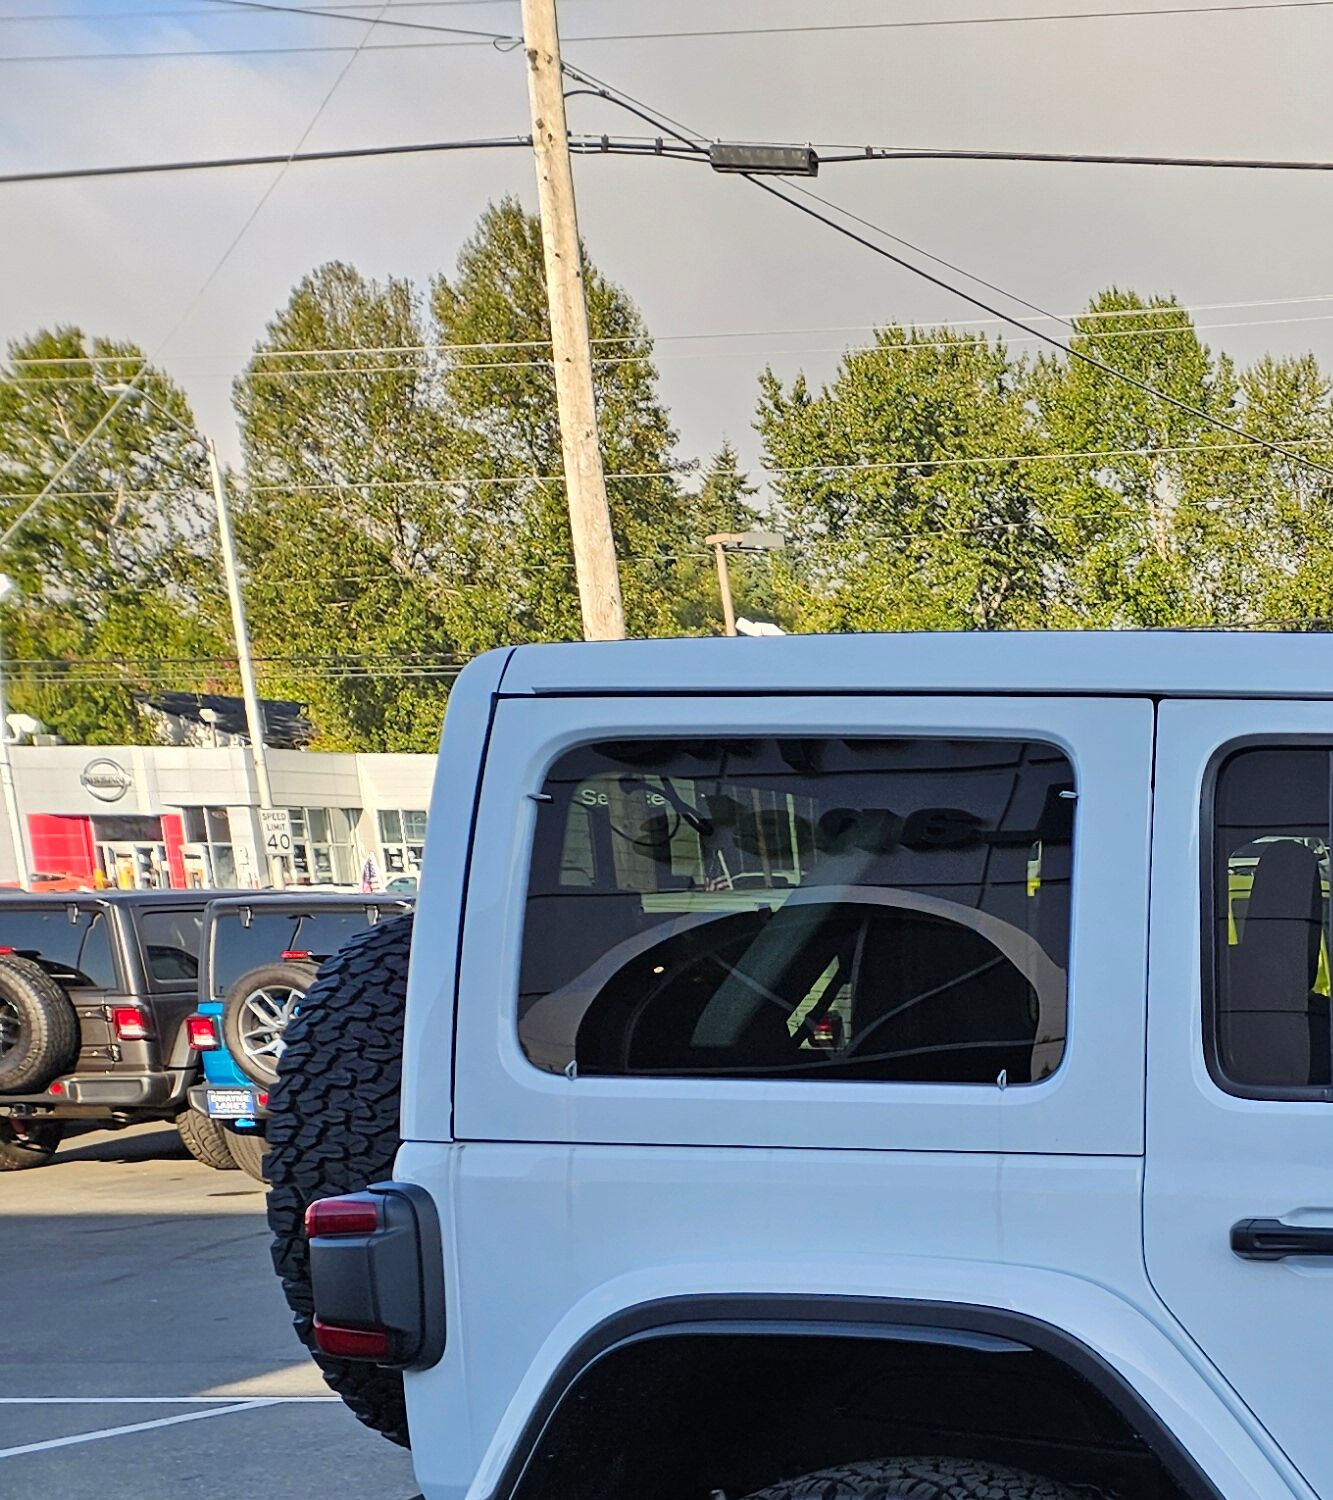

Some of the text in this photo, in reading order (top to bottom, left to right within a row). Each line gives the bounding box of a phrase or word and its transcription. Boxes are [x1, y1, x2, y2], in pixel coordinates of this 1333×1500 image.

[261, 812, 287, 821] SPEED
[266, 823, 285, 832] LIMIT
[267, 833, 290, 850] 40
